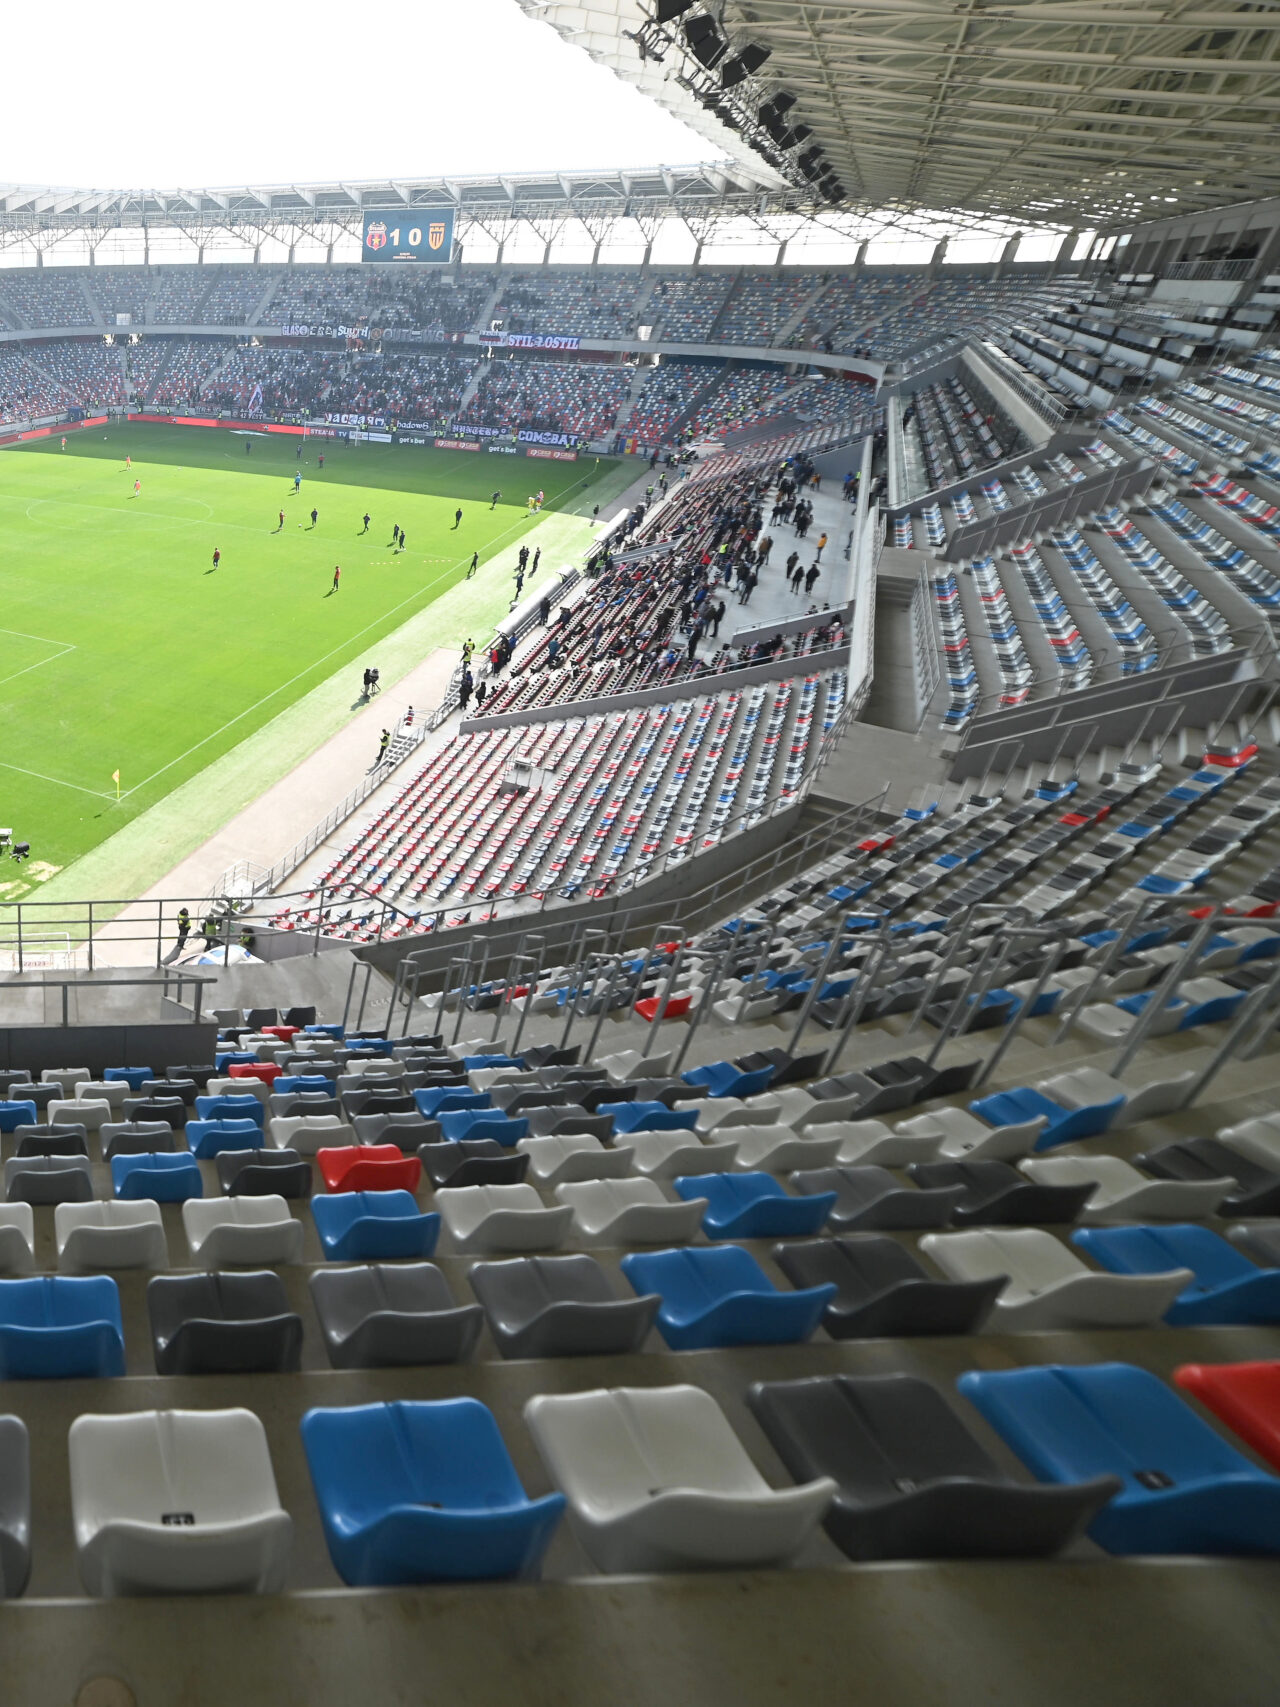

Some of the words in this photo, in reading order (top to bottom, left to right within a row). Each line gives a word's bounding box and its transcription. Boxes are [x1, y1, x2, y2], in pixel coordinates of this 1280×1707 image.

[389, 228, 400, 246] 1
[408, 228, 422, 246] 0
[518, 430, 578, 445] COMBAT
